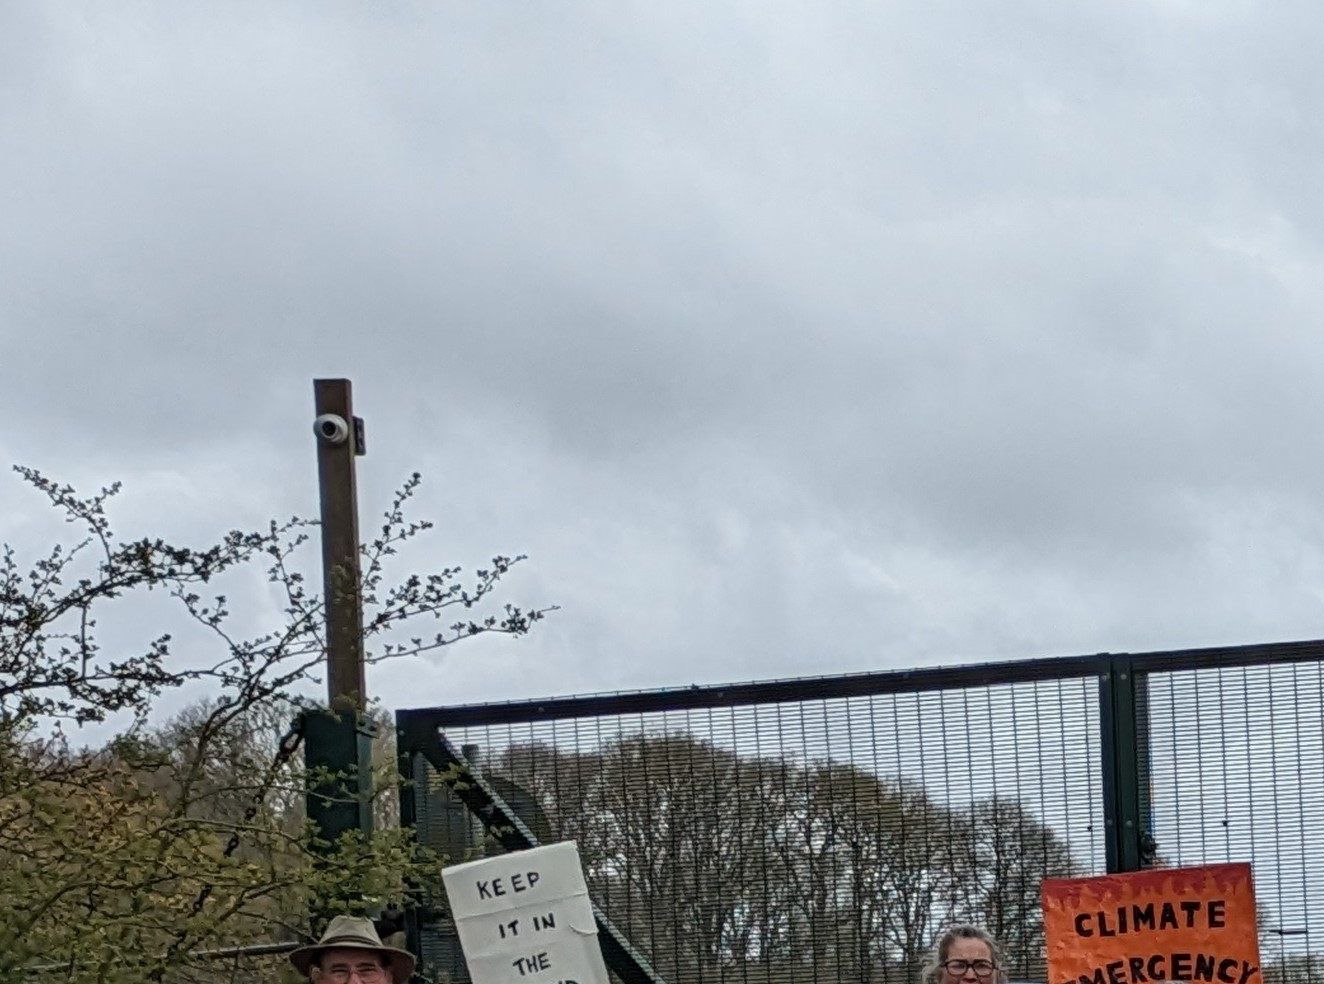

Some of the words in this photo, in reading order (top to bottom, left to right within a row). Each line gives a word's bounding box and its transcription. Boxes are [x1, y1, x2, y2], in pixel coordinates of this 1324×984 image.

[476, 871, 540, 900] KEEP
[498, 919, 520, 939] IT
[533, 912, 555, 932] IN
[1074, 900, 1226, 937] CLIMATE
[512, 952, 551, 976] THE
